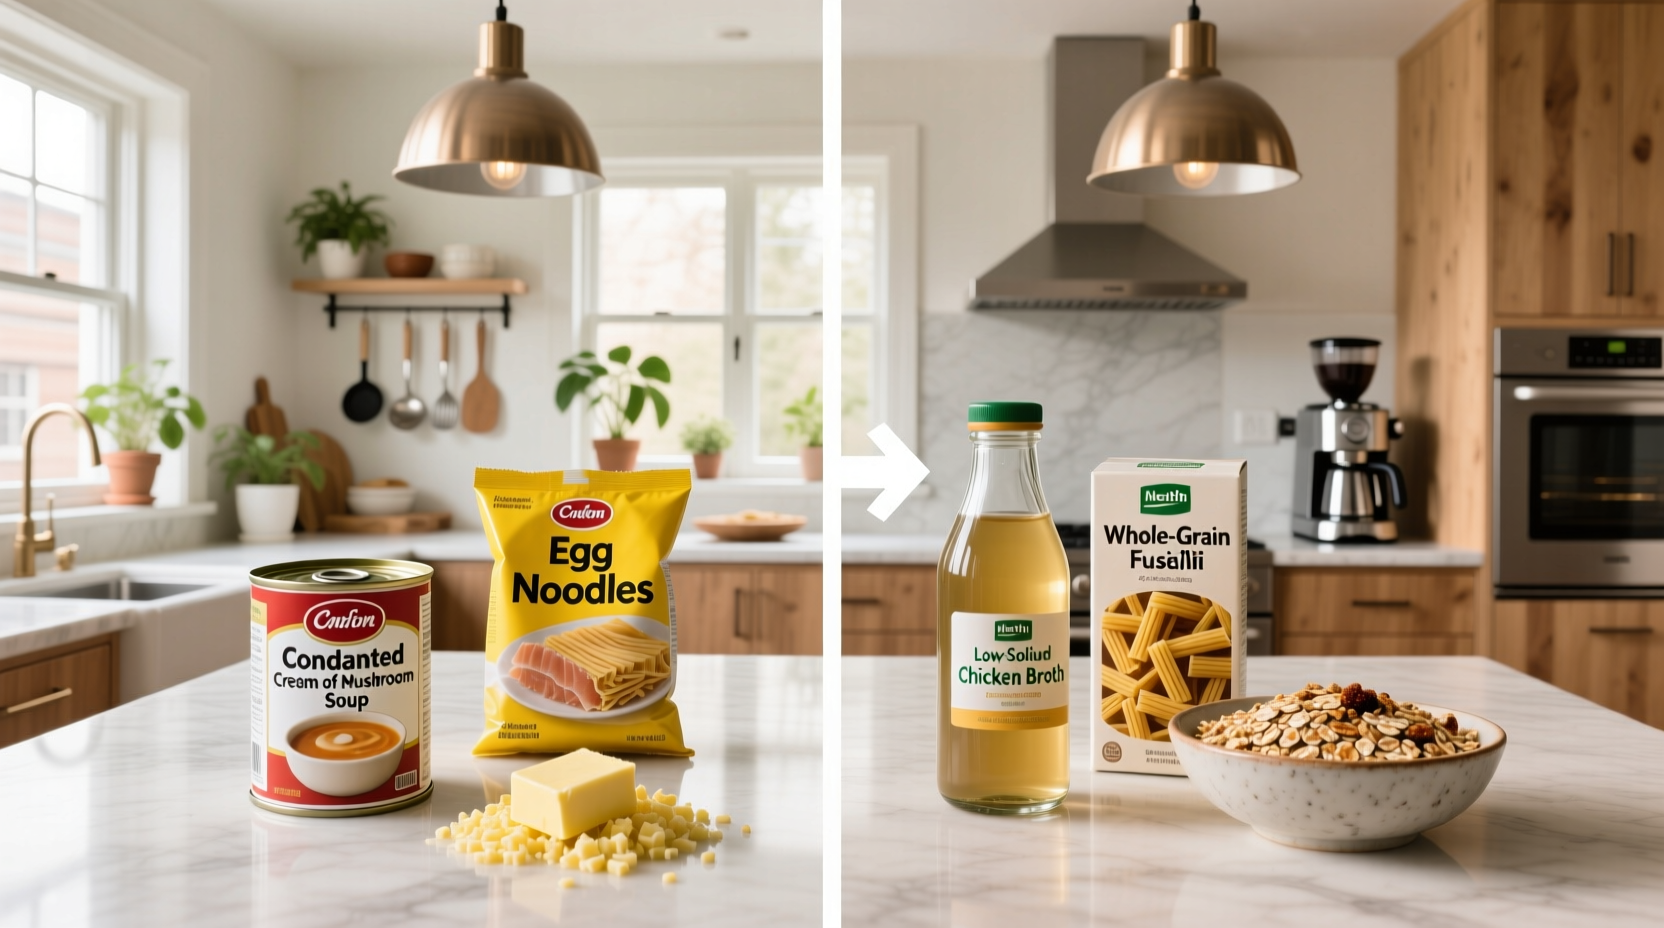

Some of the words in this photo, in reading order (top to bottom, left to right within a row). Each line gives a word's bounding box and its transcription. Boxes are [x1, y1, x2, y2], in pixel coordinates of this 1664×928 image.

[1103, 524, 1231, 546] Whole-Grain
[549, 536, 613, 573] Egg
[512, 572, 654, 605] Noodles
[282, 643, 405, 671] Condanted
[322, 673, 338, 689] of
[341, 670, 414, 689] Mushroom
[958, 665, 1021, 686] Chicken
[1026, 663, 1065, 685] Broth
[325, 692, 369, 712] Soup
